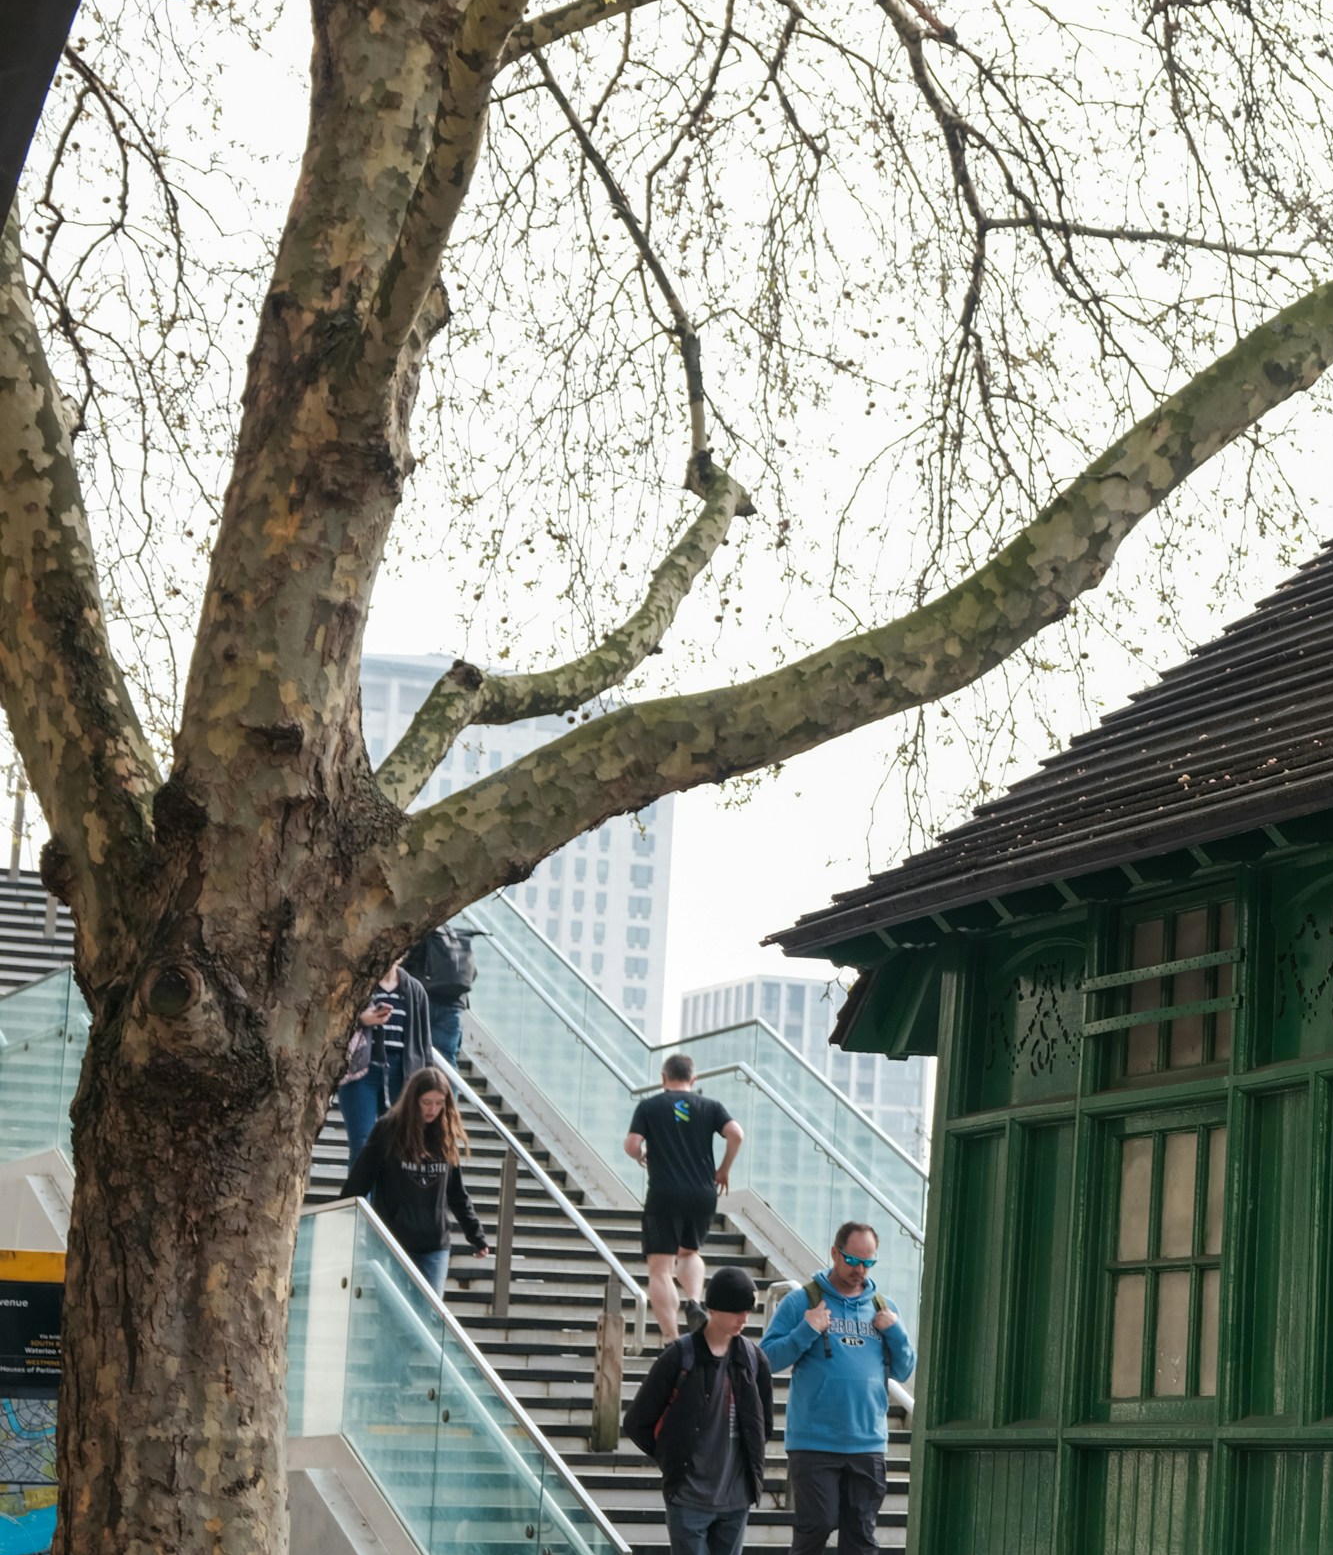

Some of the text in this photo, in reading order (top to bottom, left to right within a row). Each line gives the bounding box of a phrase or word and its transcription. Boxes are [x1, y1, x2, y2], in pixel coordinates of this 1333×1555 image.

[0, 1298, 28, 1307] venue
[828, 1317, 855, 1334] ERO
[0, 1365, 25, 1373] Houses
[36, 1366, 62, 1374] Parliam
